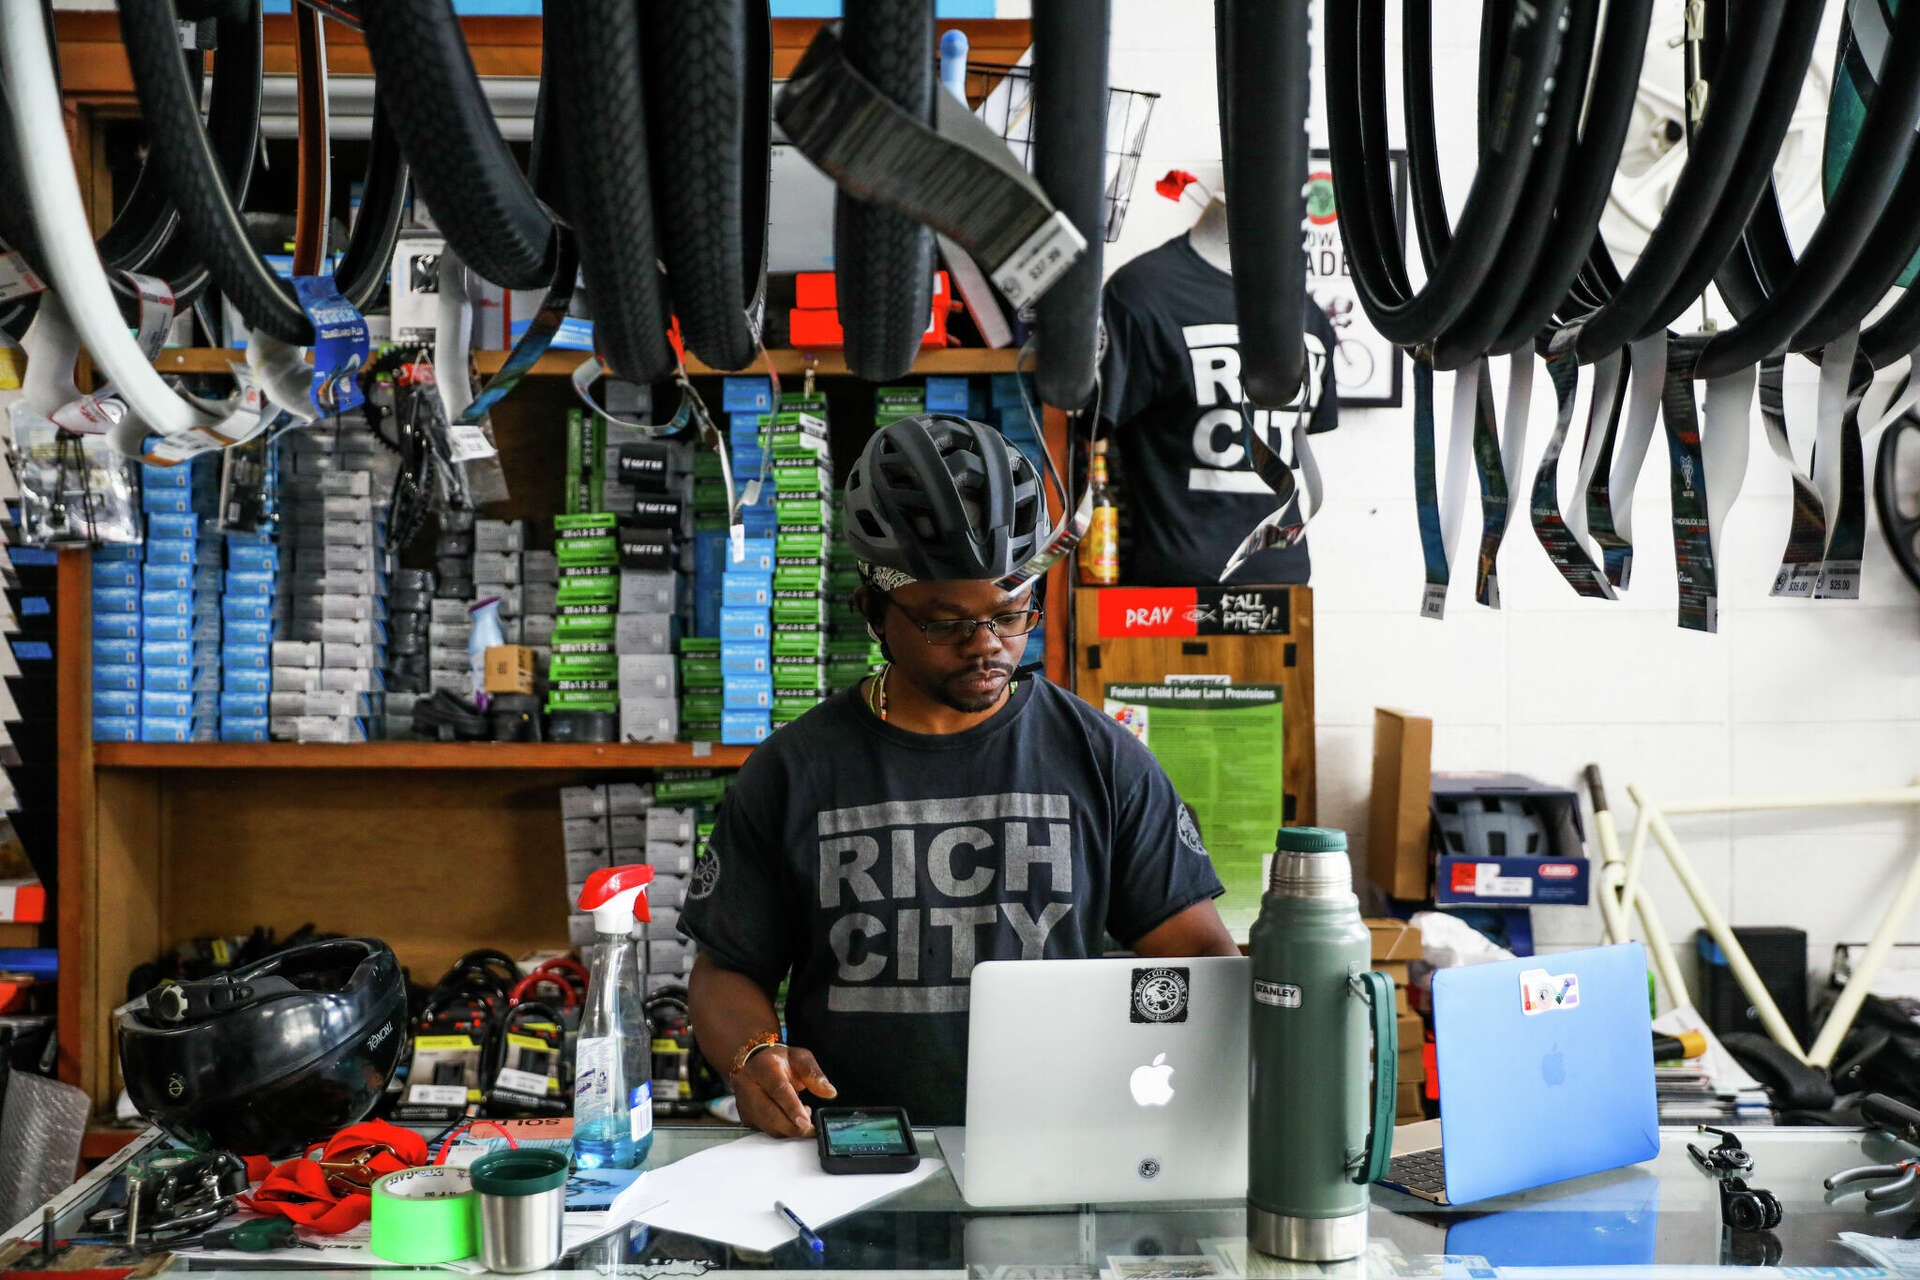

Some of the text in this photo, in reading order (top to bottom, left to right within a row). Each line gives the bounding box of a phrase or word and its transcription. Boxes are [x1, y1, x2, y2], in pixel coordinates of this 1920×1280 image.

[1220, 593, 1266, 610] FALL
[1125, 605, 1175, 629] PRAY
[1222, 606, 1280, 630] PREY!
[1110, 686, 1276, 700] Federal Child Labor Law Provisions
[818, 821, 1073, 909] RICH
[828, 903, 1073, 981] CITY
[1255, 983, 1297, 998] STANLEY
